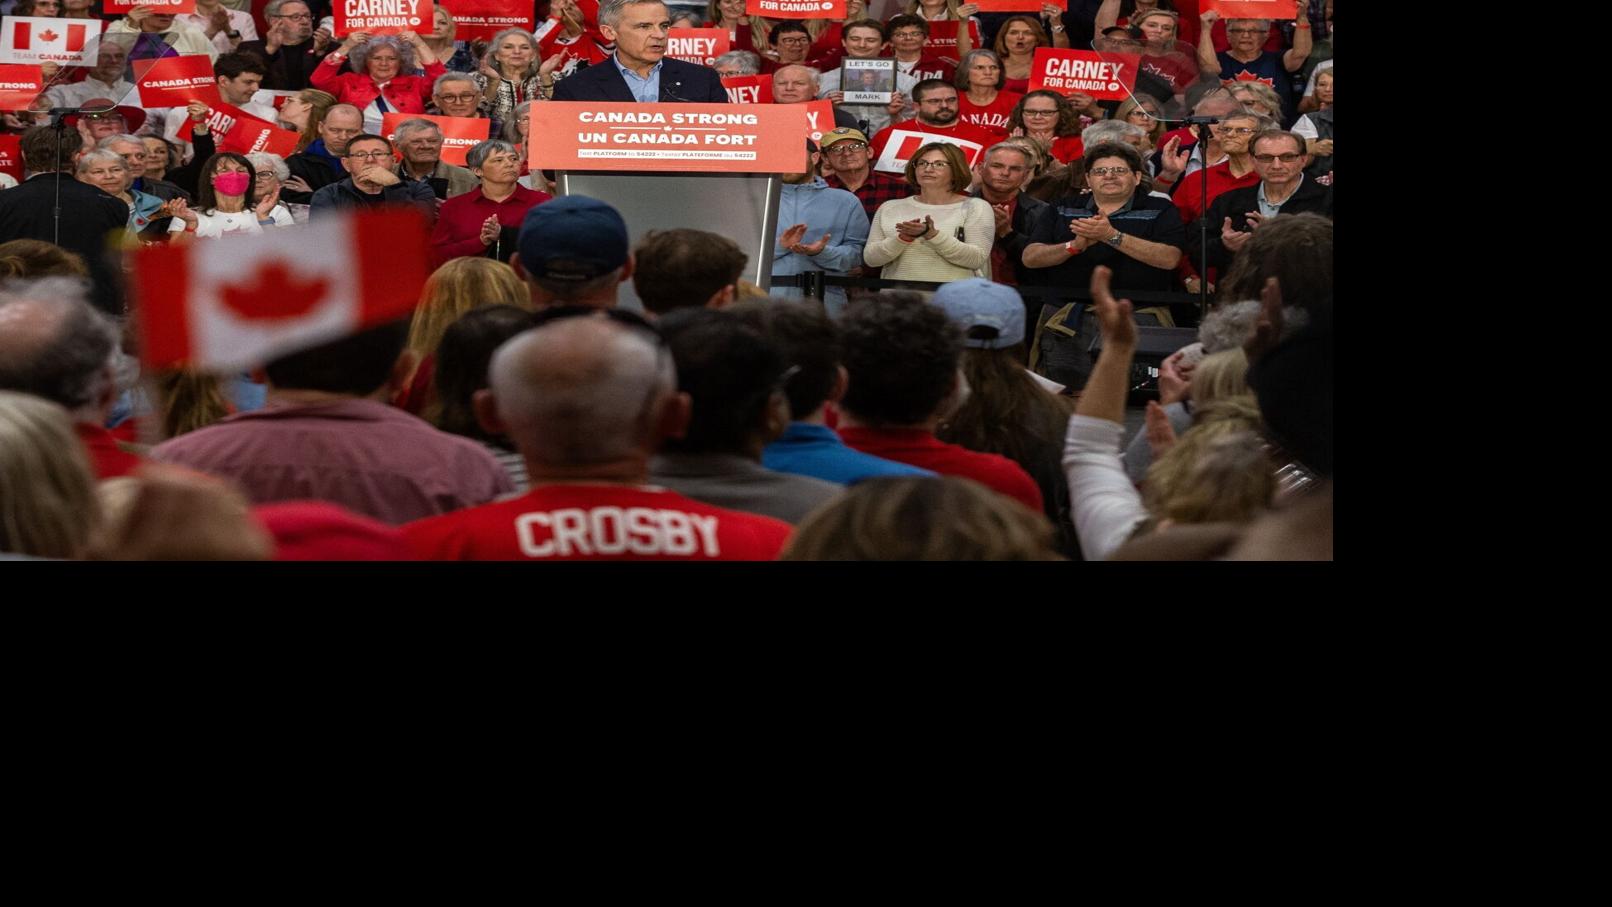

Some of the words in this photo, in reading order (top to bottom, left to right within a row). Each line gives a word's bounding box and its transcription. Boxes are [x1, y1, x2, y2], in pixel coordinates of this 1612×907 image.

[345, 0, 419, 17] CARNEY
[760, 1, 778, 10] FOR
[780, 2, 820, 11] CANADA
[346, 18, 365, 28] FOR
[366, 16, 407, 27] CANADA
[665, 37, 717, 55] RNEY
[38, 53, 82, 61] CANADA
[1045, 58, 1124, 80] CARNEY
[143, 79, 191, 88] CANADA
[1043, 77, 1062, 87] FOR
[1065, 79, 1106, 91] CANADA
[727, 85, 760, 103] NEY
[579, 112, 665, 123] CANADA
[672, 113, 757, 124] STRONG
[248, 129, 272, 154] TRONG
[578, 133, 606, 143] UN
[613, 134, 698, 144] CANADA
[704, 135, 757, 145] FORT
[514, 506, 720, 557] CROSBY
